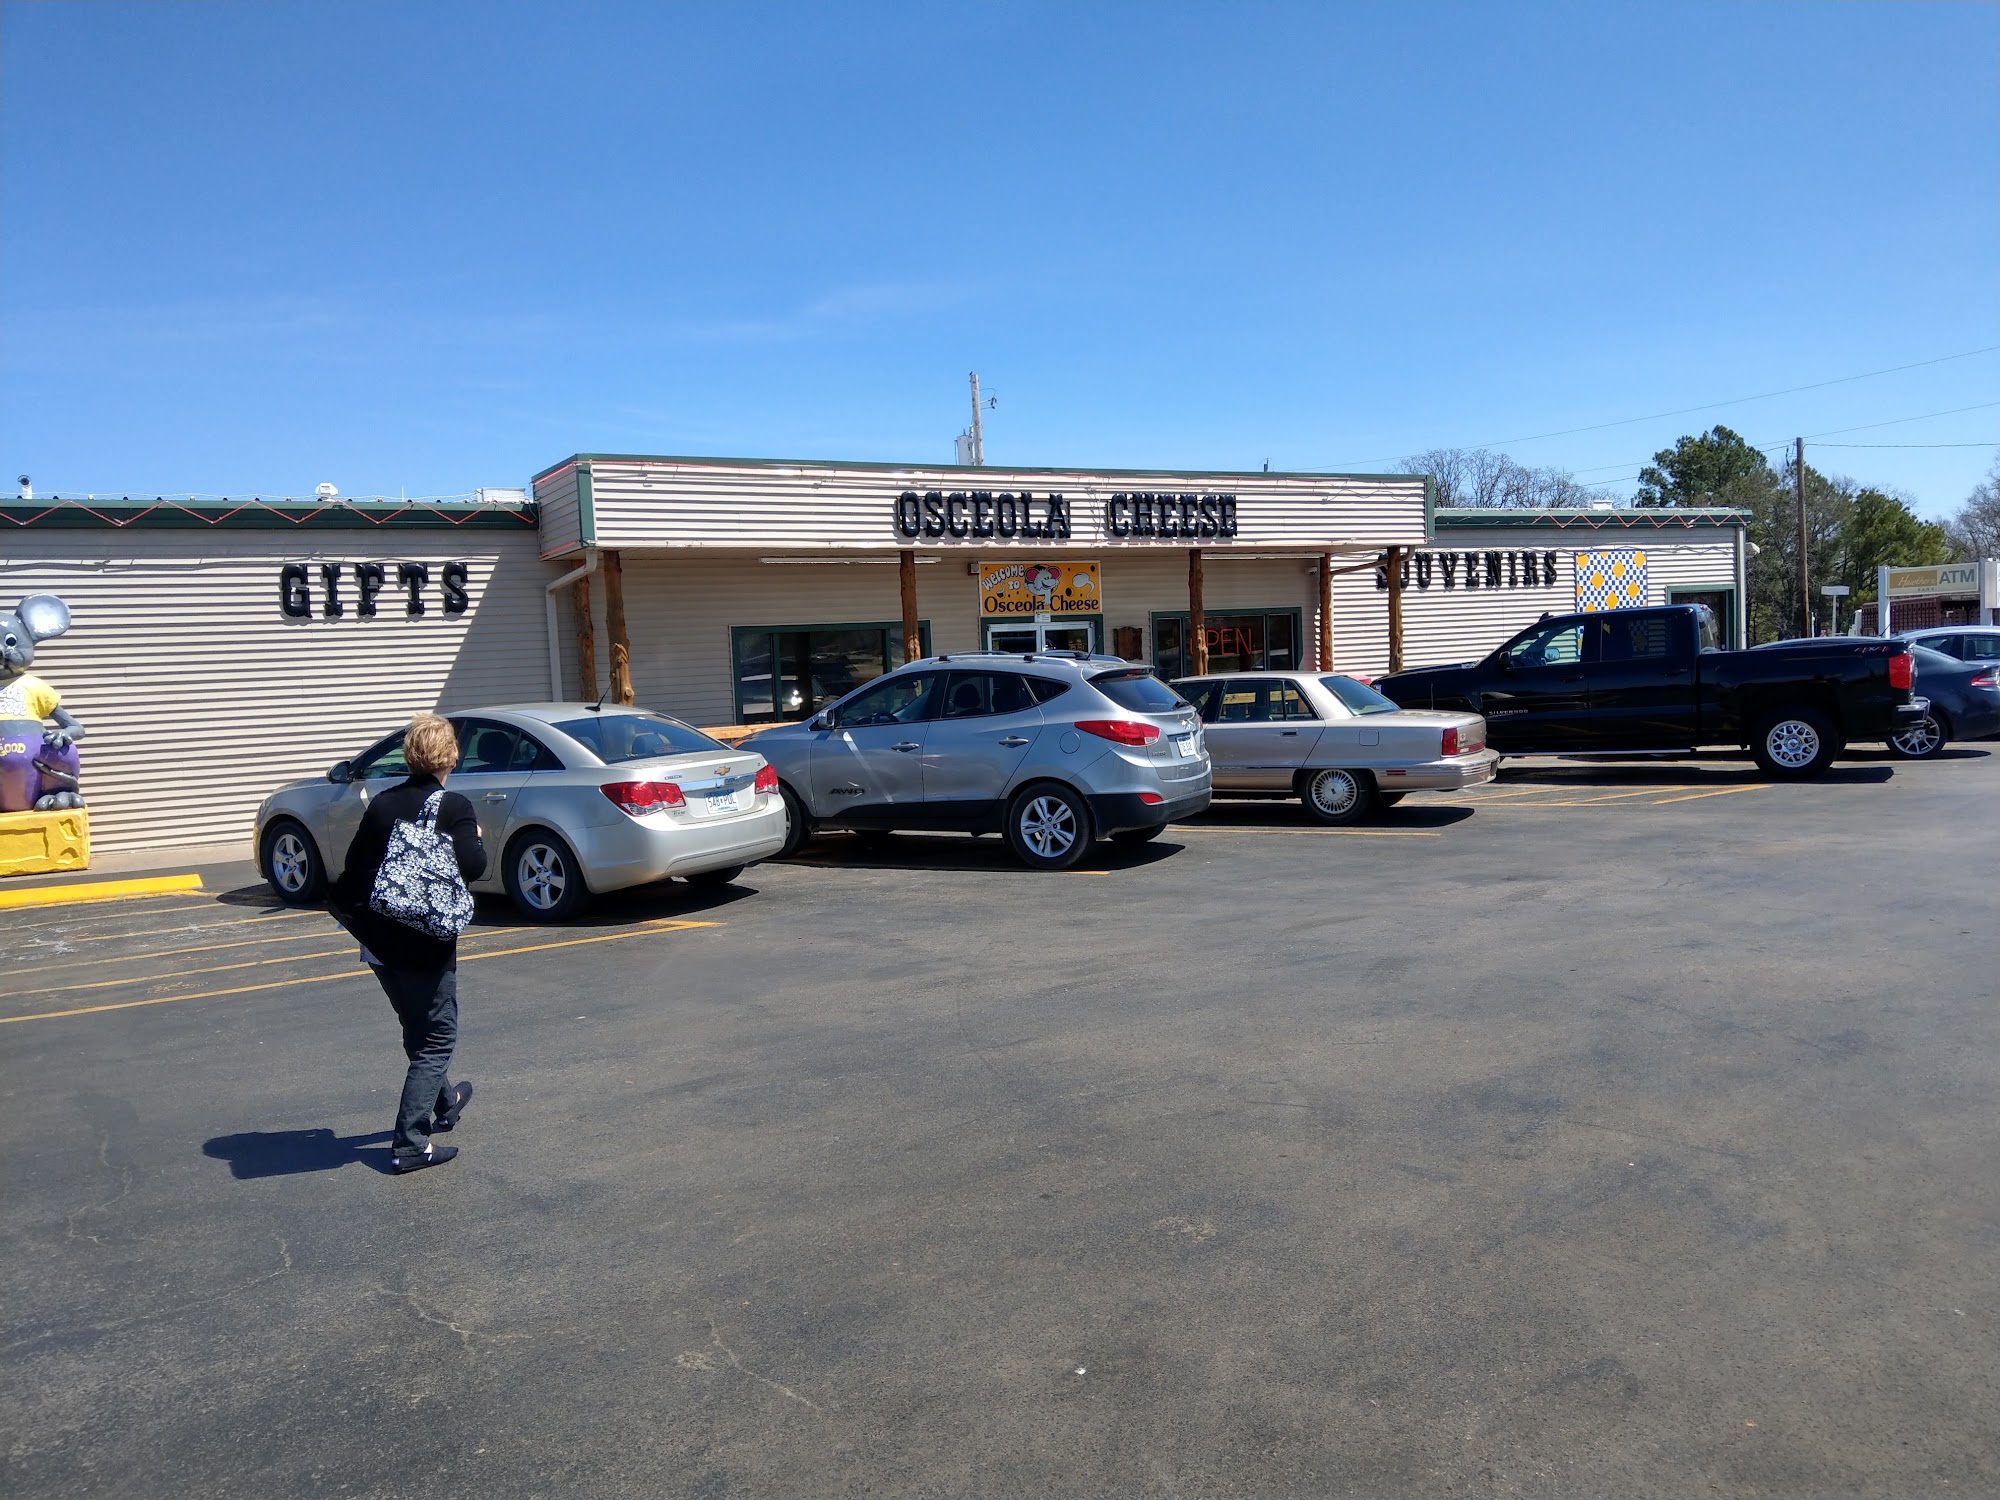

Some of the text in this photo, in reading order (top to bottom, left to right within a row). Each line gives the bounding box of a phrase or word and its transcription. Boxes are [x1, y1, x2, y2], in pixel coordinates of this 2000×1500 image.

[899, 490, 1237, 538] OSCEOLA CHEESE
[1939, 569, 1975, 585] ATM
[281, 562, 468, 618] GIFTS
[984, 595, 1099, 612] Osceola Cheese
[1189, 628, 1252, 655] PEN
[1488, 708, 1529, 716] SILVERADO
[828, 787, 865, 796] AWD
